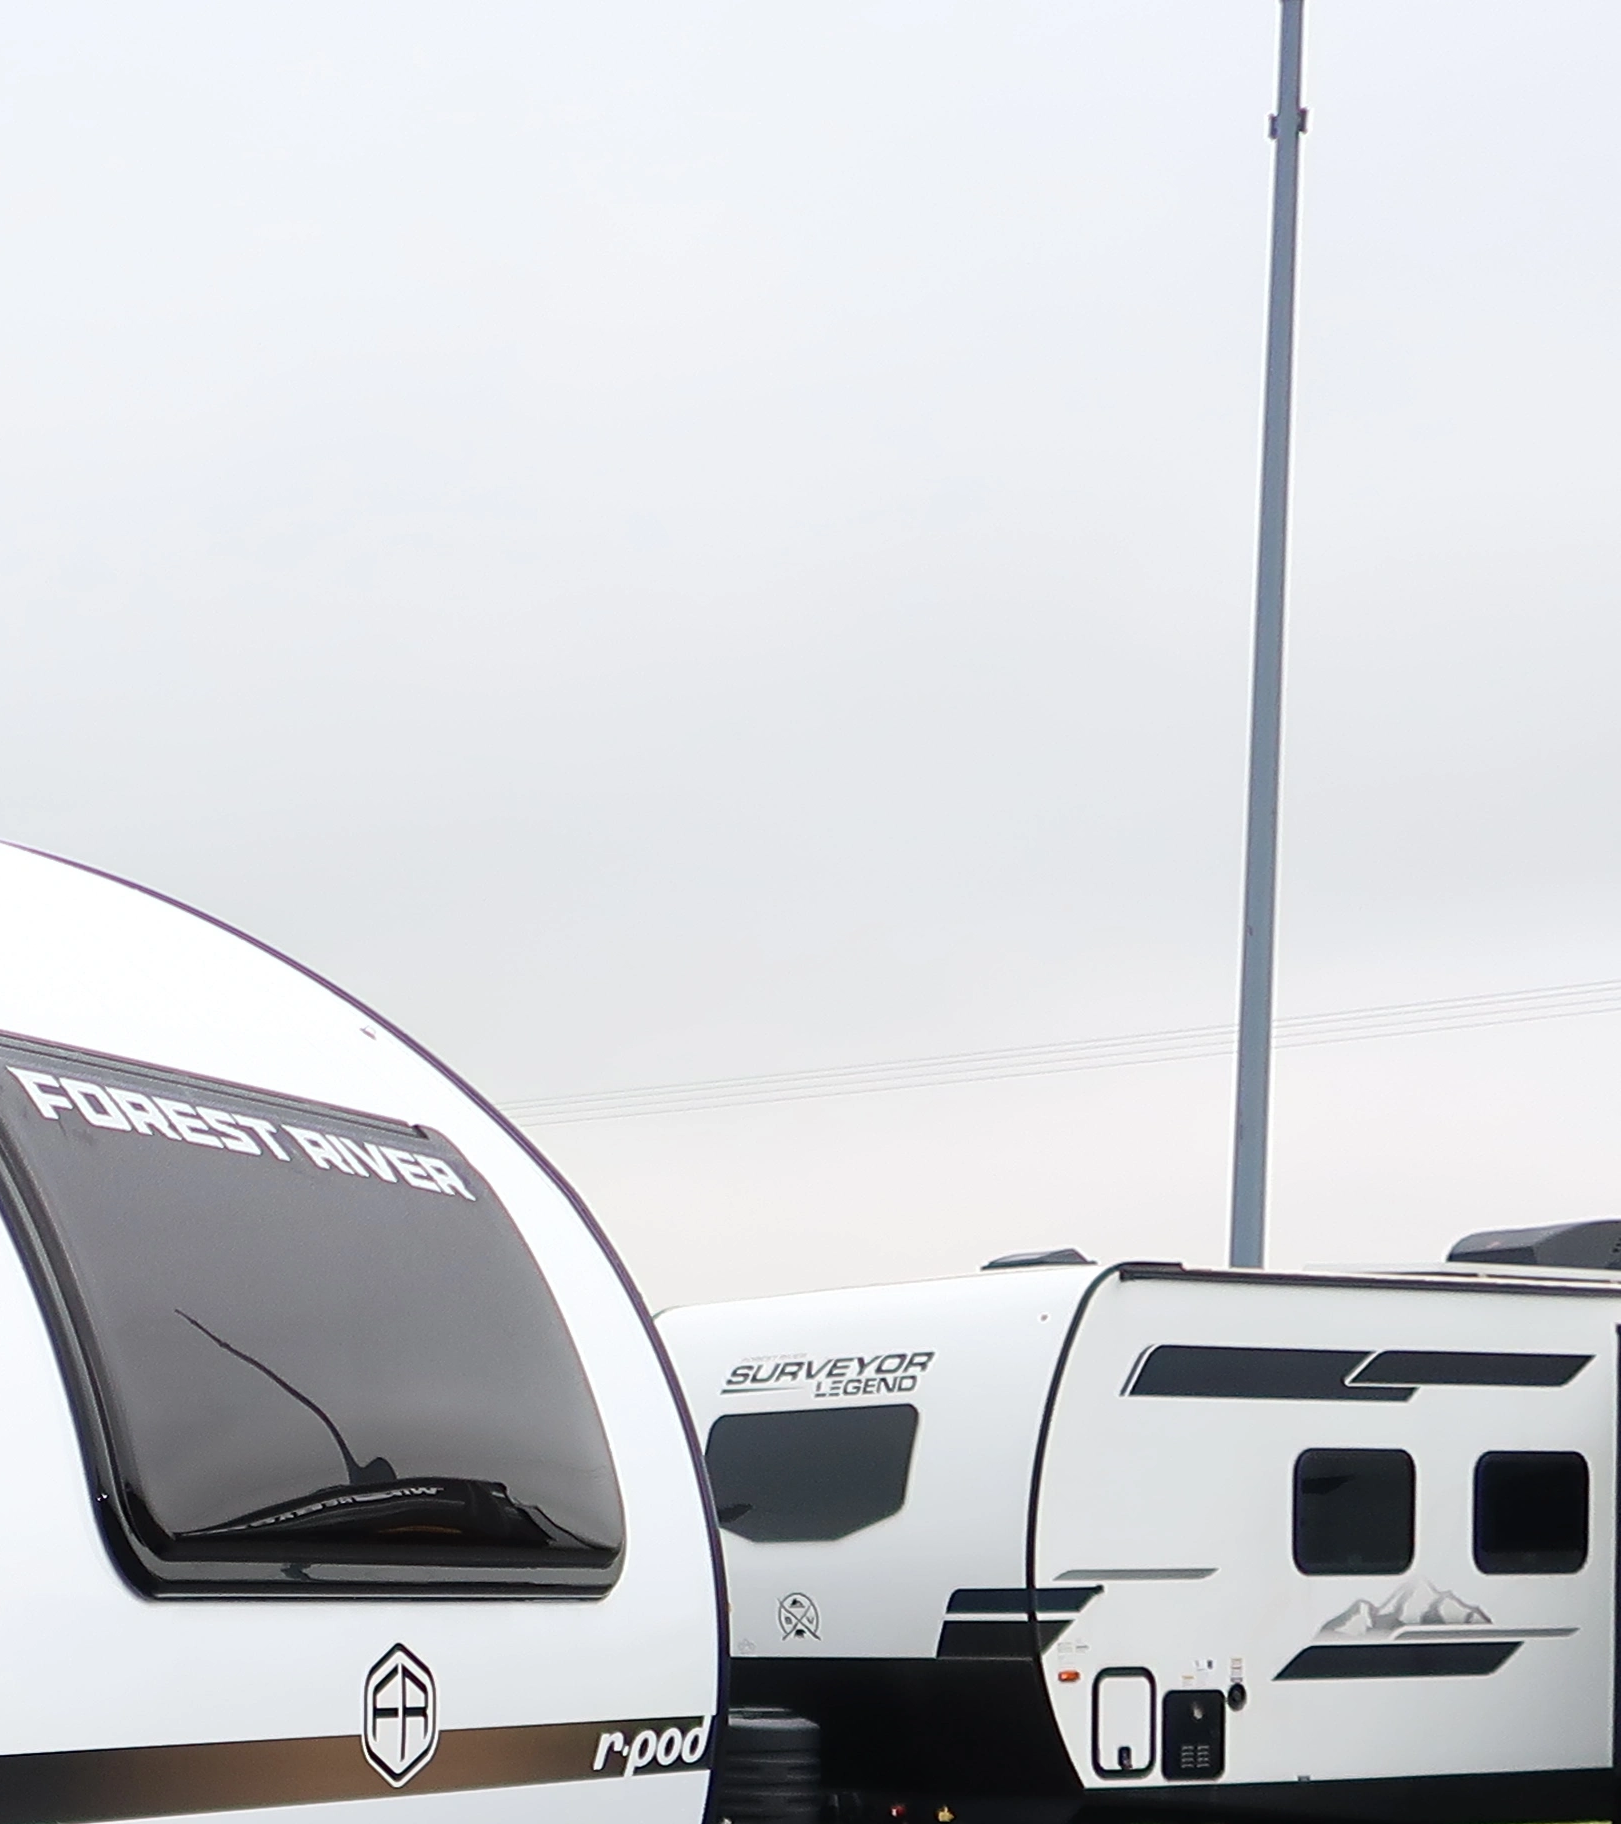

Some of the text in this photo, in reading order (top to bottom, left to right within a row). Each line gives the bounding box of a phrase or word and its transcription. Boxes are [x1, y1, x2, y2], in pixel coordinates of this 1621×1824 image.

[6, 1065, 477, 1201] FOREST RIVER
[725, 1351, 936, 1386] SURVEYOR
[813, 1375, 918, 1399] LEGEND
